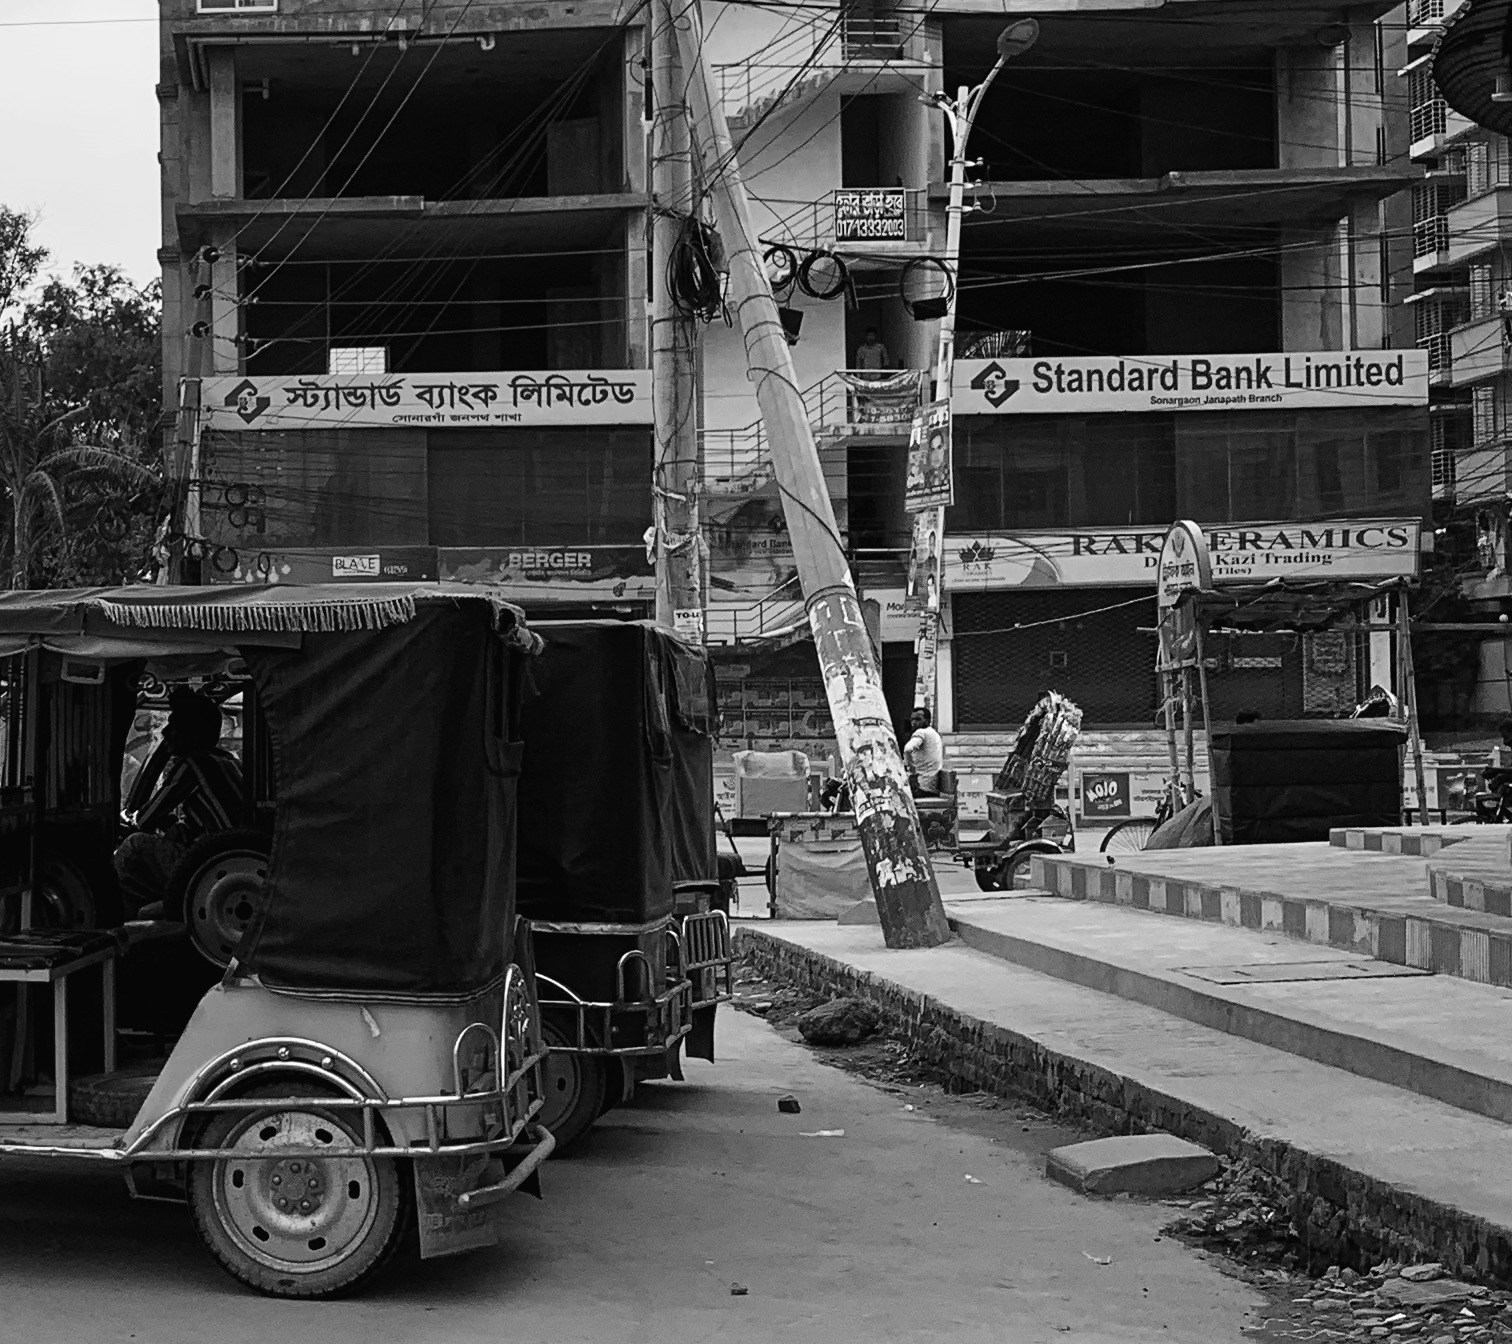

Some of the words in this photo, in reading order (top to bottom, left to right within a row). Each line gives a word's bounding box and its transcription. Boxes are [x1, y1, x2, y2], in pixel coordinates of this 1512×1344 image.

[1032, 359, 1179, 394] Standard
[1191, 358, 1274, 391] Bank
[1285, 354, 1404, 388] Limited
[412, 381, 500, 410] ব্যাংক
[507, 374, 637, 408] লিমিটেড
[1150, 395, 1201, 406] Sonargaon
[1203, 394, 1247, 405] Janapath
[1248, 392, 1283, 404] Branch
[1072, 534, 1164, 556] RAK
[1206, 527, 1409, 552] ERAMICS
[509, 552, 592, 568] BERGER
[1215, 554, 1256, 565] Kazi
[1260, 551, 1333, 564] Trading
